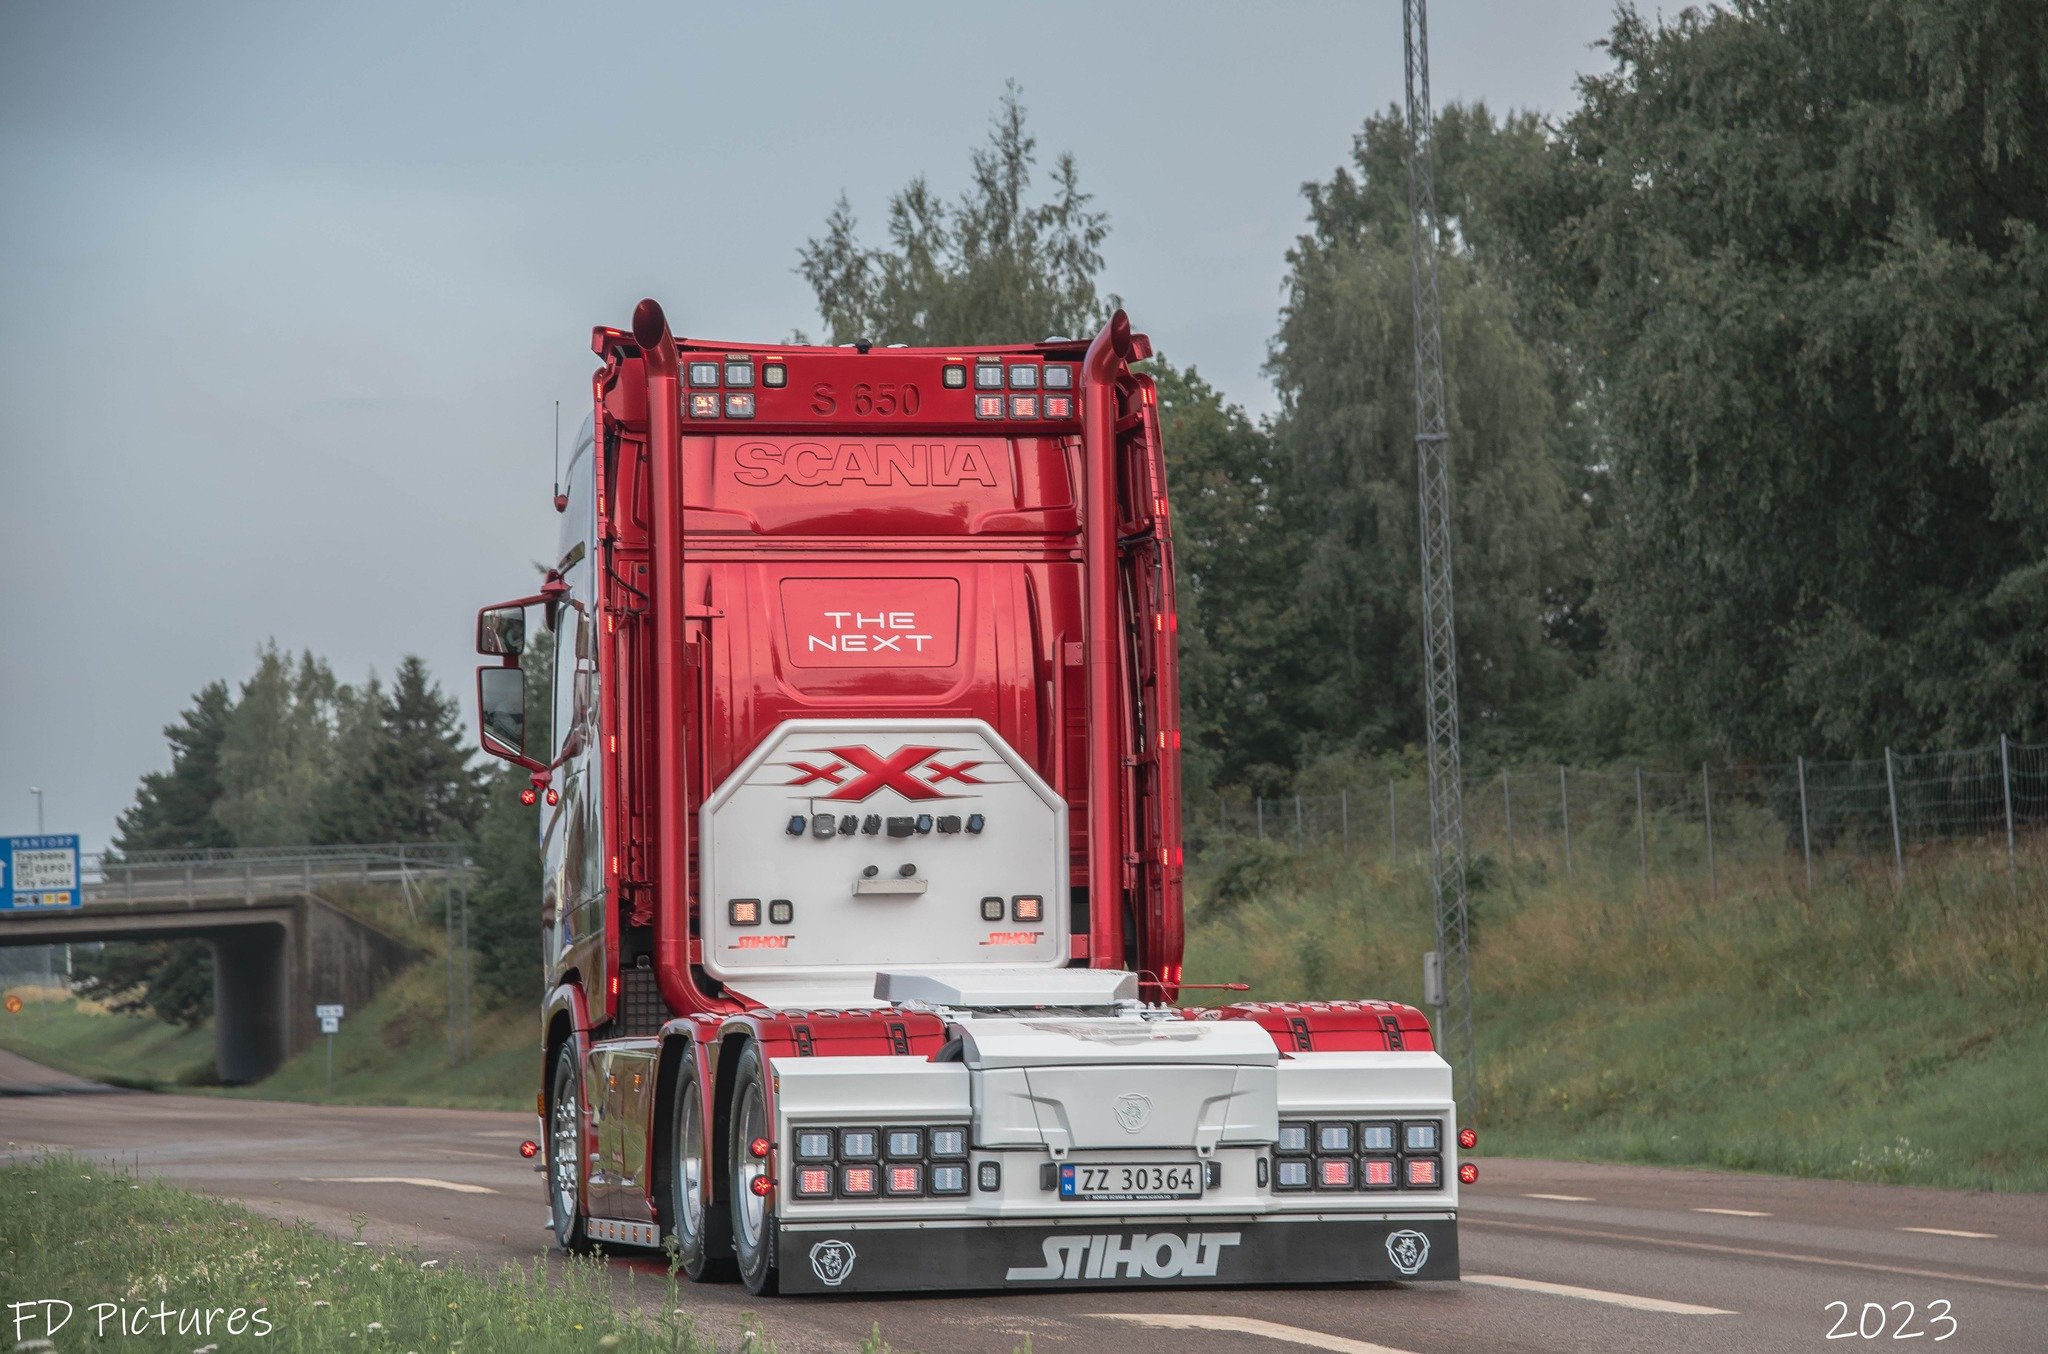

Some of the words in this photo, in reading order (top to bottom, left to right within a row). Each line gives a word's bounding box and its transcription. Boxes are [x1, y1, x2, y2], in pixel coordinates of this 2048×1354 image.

[811, 383, 836, 417] S
[853, 382, 921, 417] 650
[733, 441, 997, 487] SCANIA
[824, 612, 916, 629] THE
[808, 634, 933, 652] NEXT
[11, 837, 73, 848] MANTORP
[35, 863, 72, 874] DEPOT
[728, 935, 795, 949] STIHOLT
[978, 931, 1044, 946] STIHOLT
[1082, 1169, 1109, 1191] ZZ
[1121, 1168, 1194, 1190] 30364
[1005, 1232, 1241, 1281] STIHOLT
